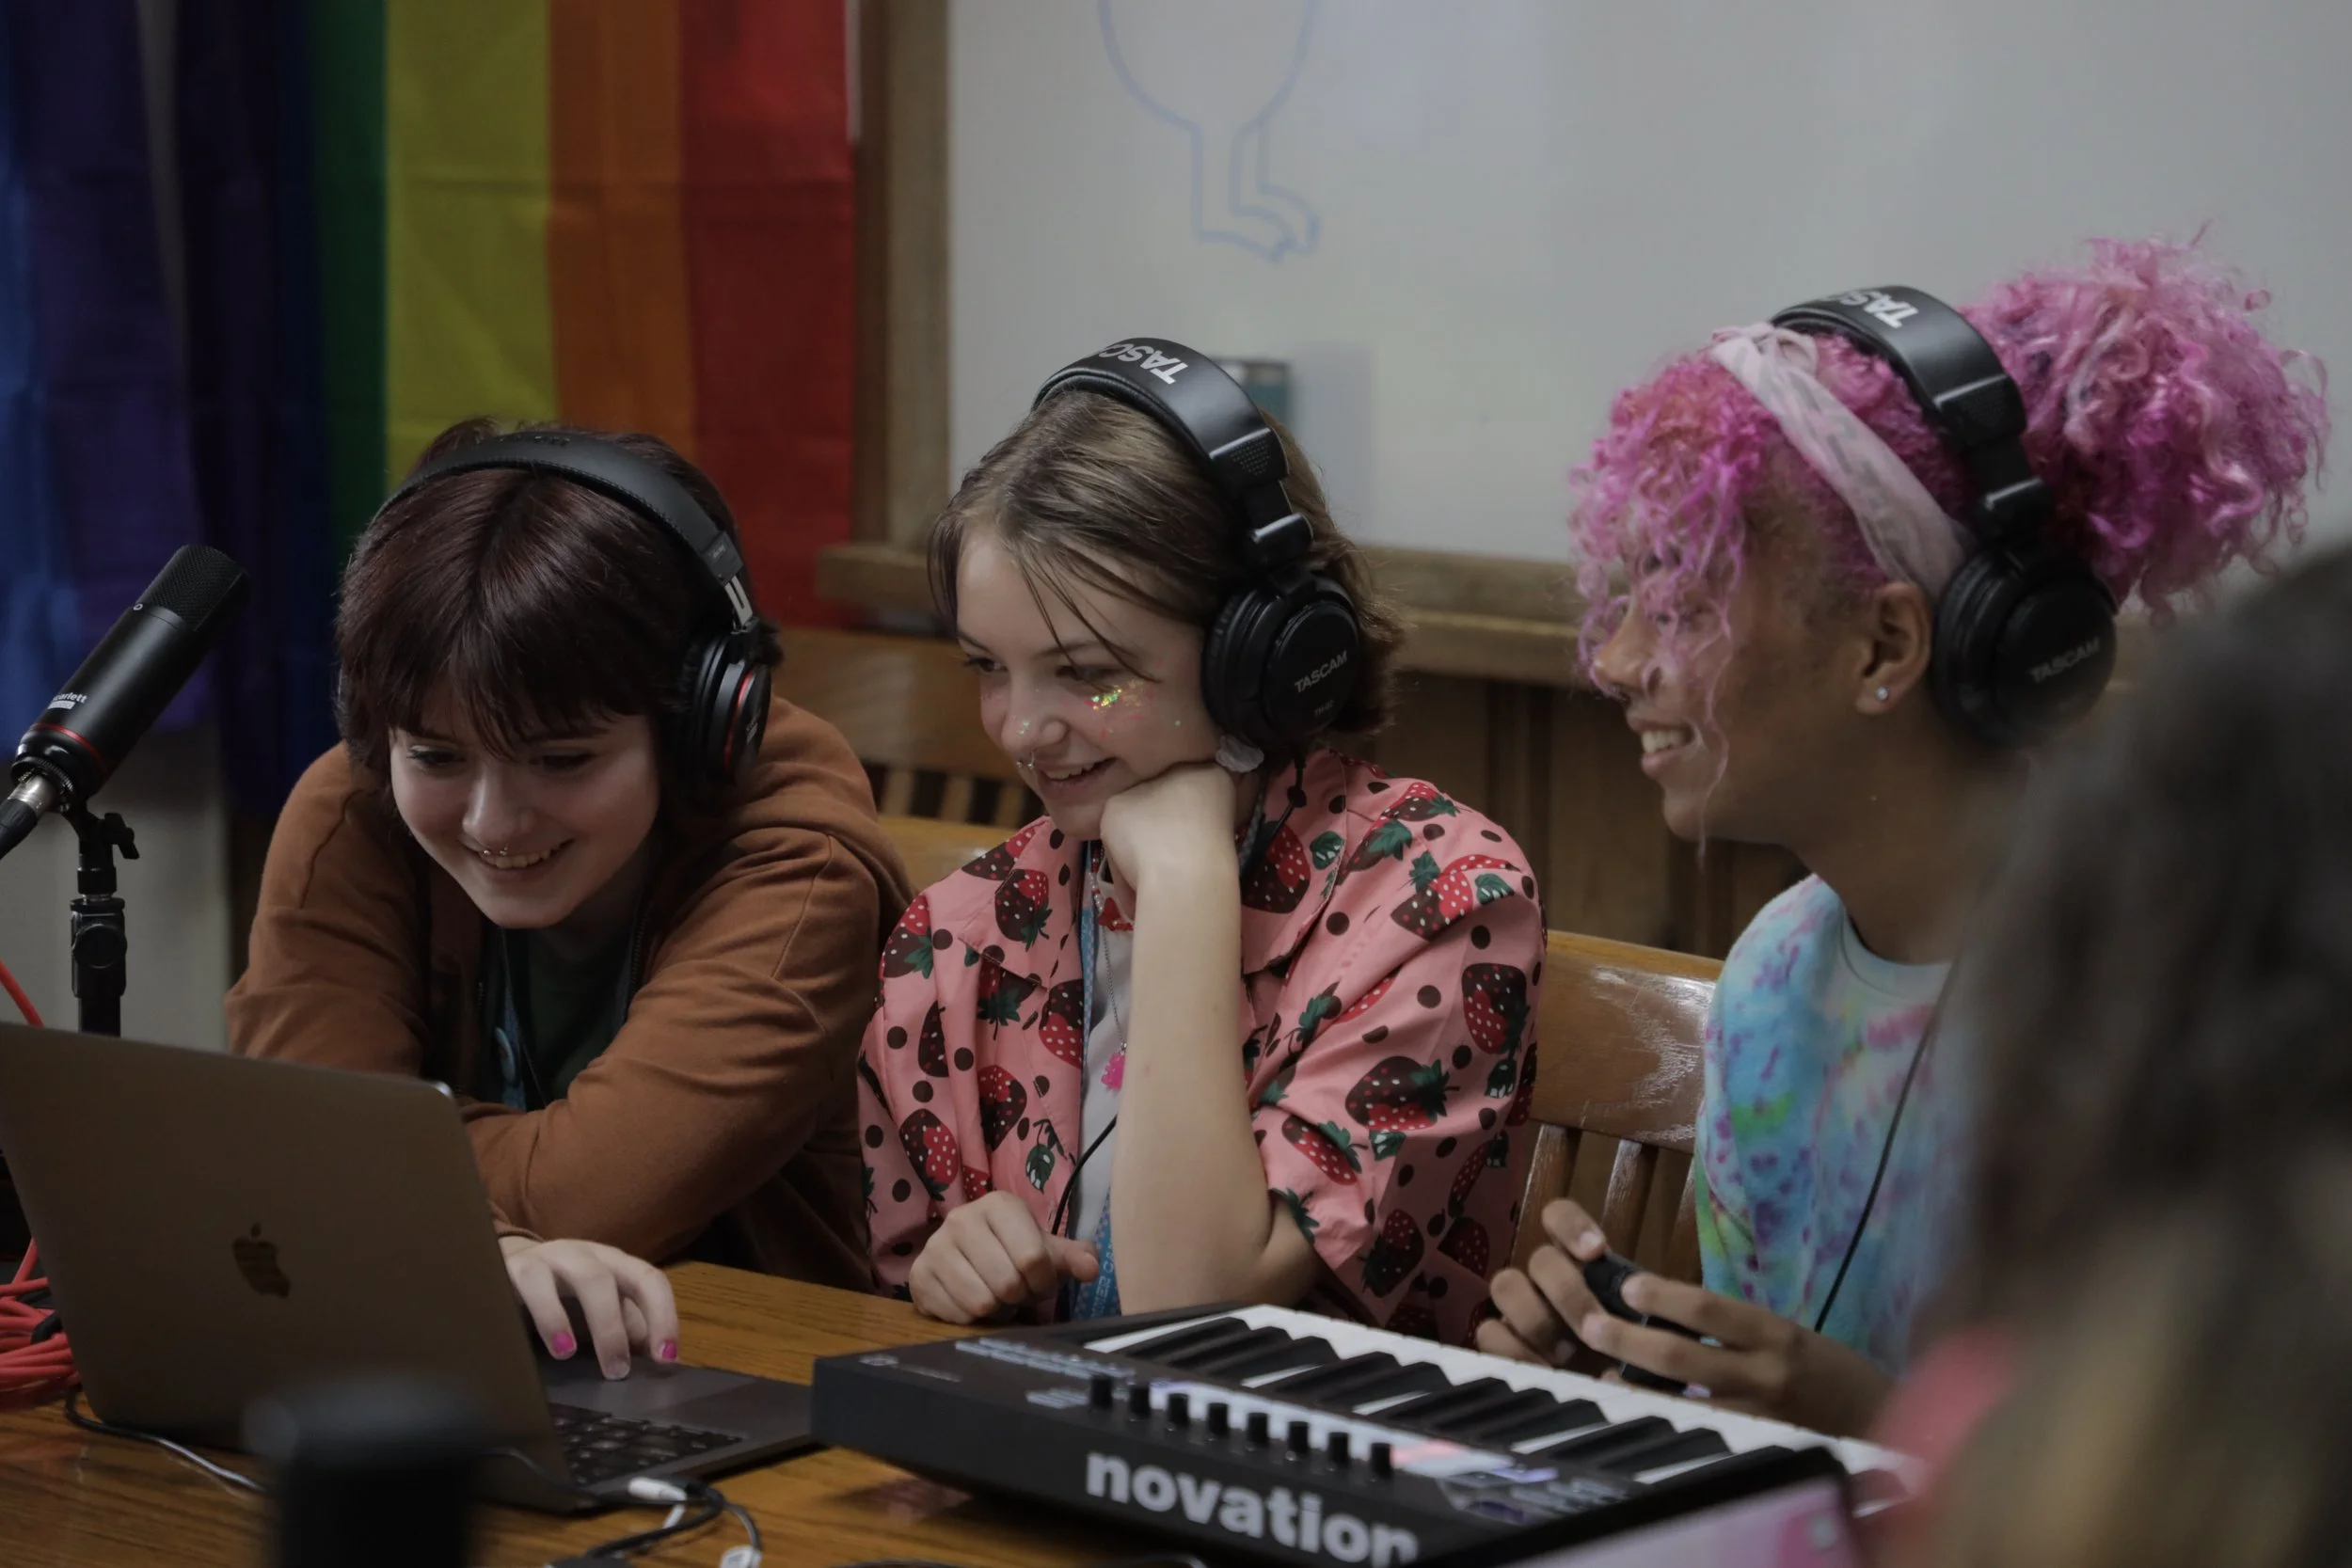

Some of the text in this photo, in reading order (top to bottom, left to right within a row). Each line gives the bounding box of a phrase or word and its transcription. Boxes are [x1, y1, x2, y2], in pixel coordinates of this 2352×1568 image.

[1294, 649, 1347, 693] TASCAM
[2027, 636, 2100, 684] TASCAM
[1085, 1451, 1421, 1568] novation
